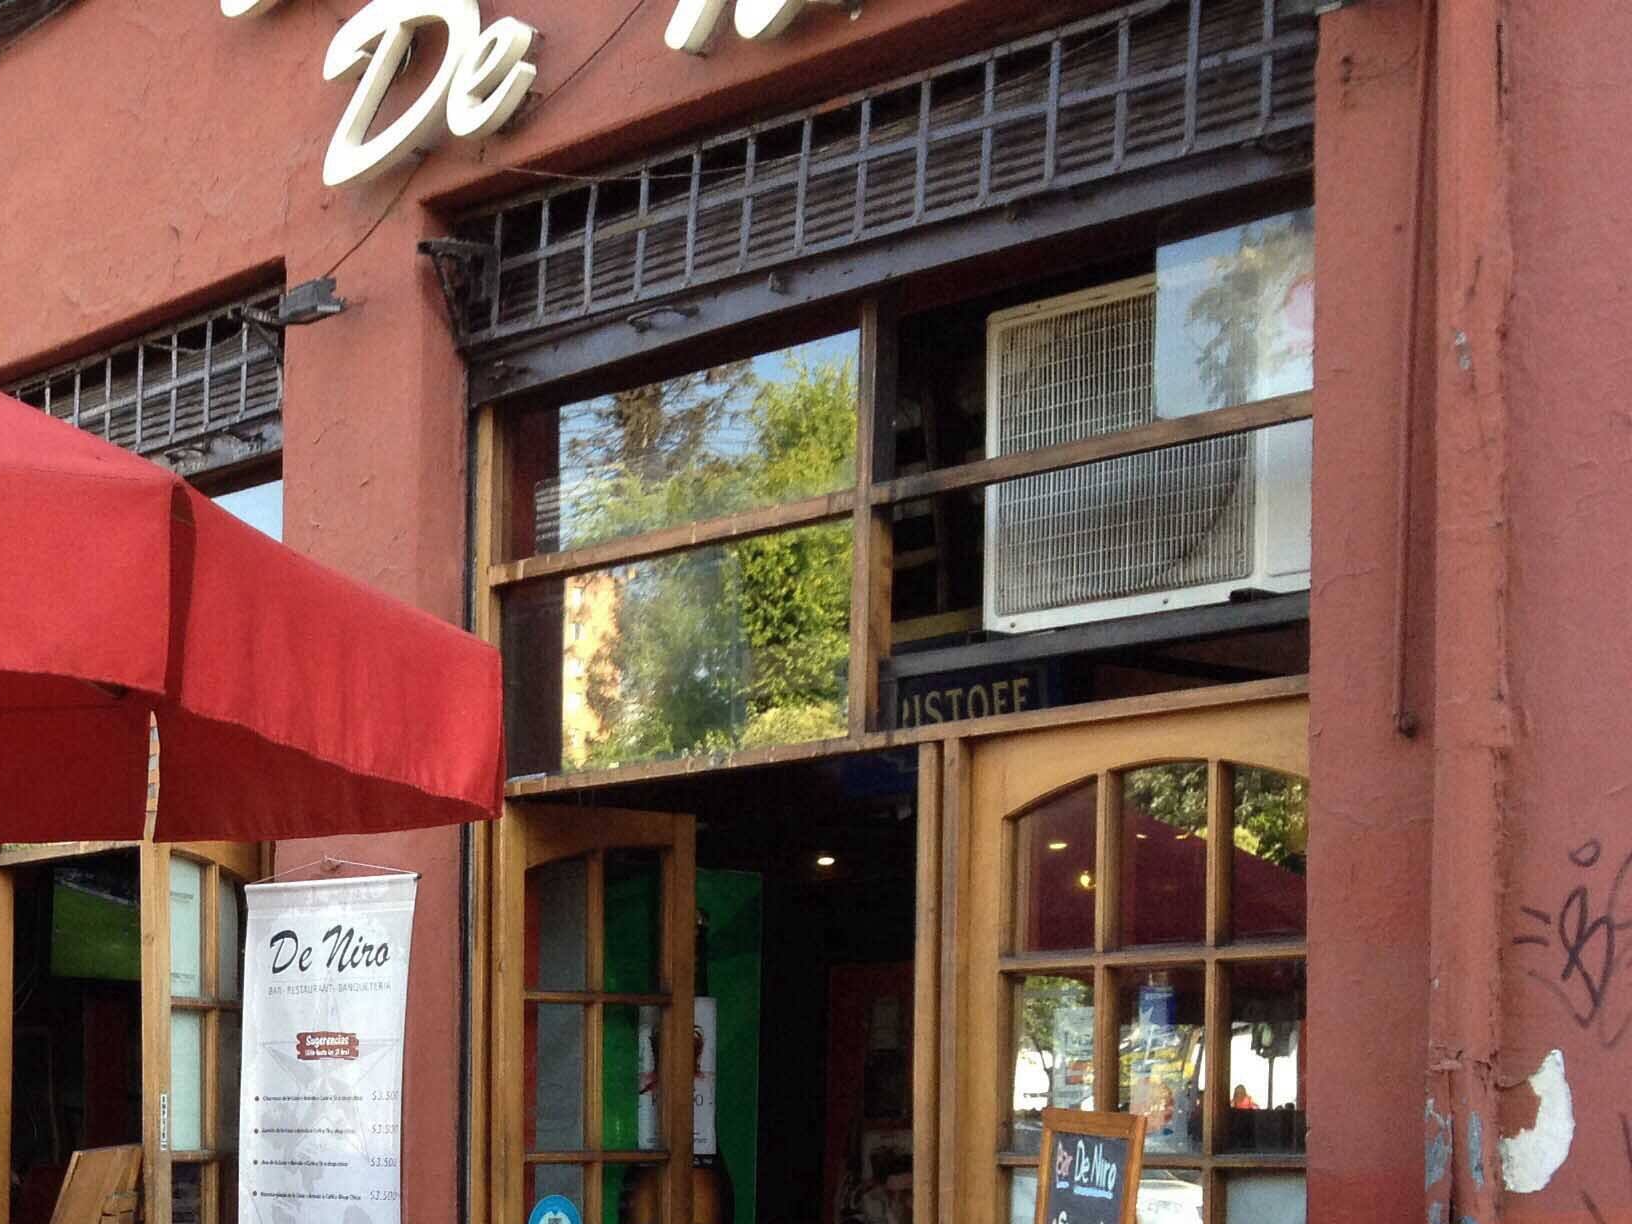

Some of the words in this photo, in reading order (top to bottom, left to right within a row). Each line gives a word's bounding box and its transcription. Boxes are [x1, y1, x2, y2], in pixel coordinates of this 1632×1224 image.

[323, 0, 536, 186] De
[270, 930, 312, 974] De
[322, 925, 390, 973] Niro
[1074, 1140, 1090, 1184] De
